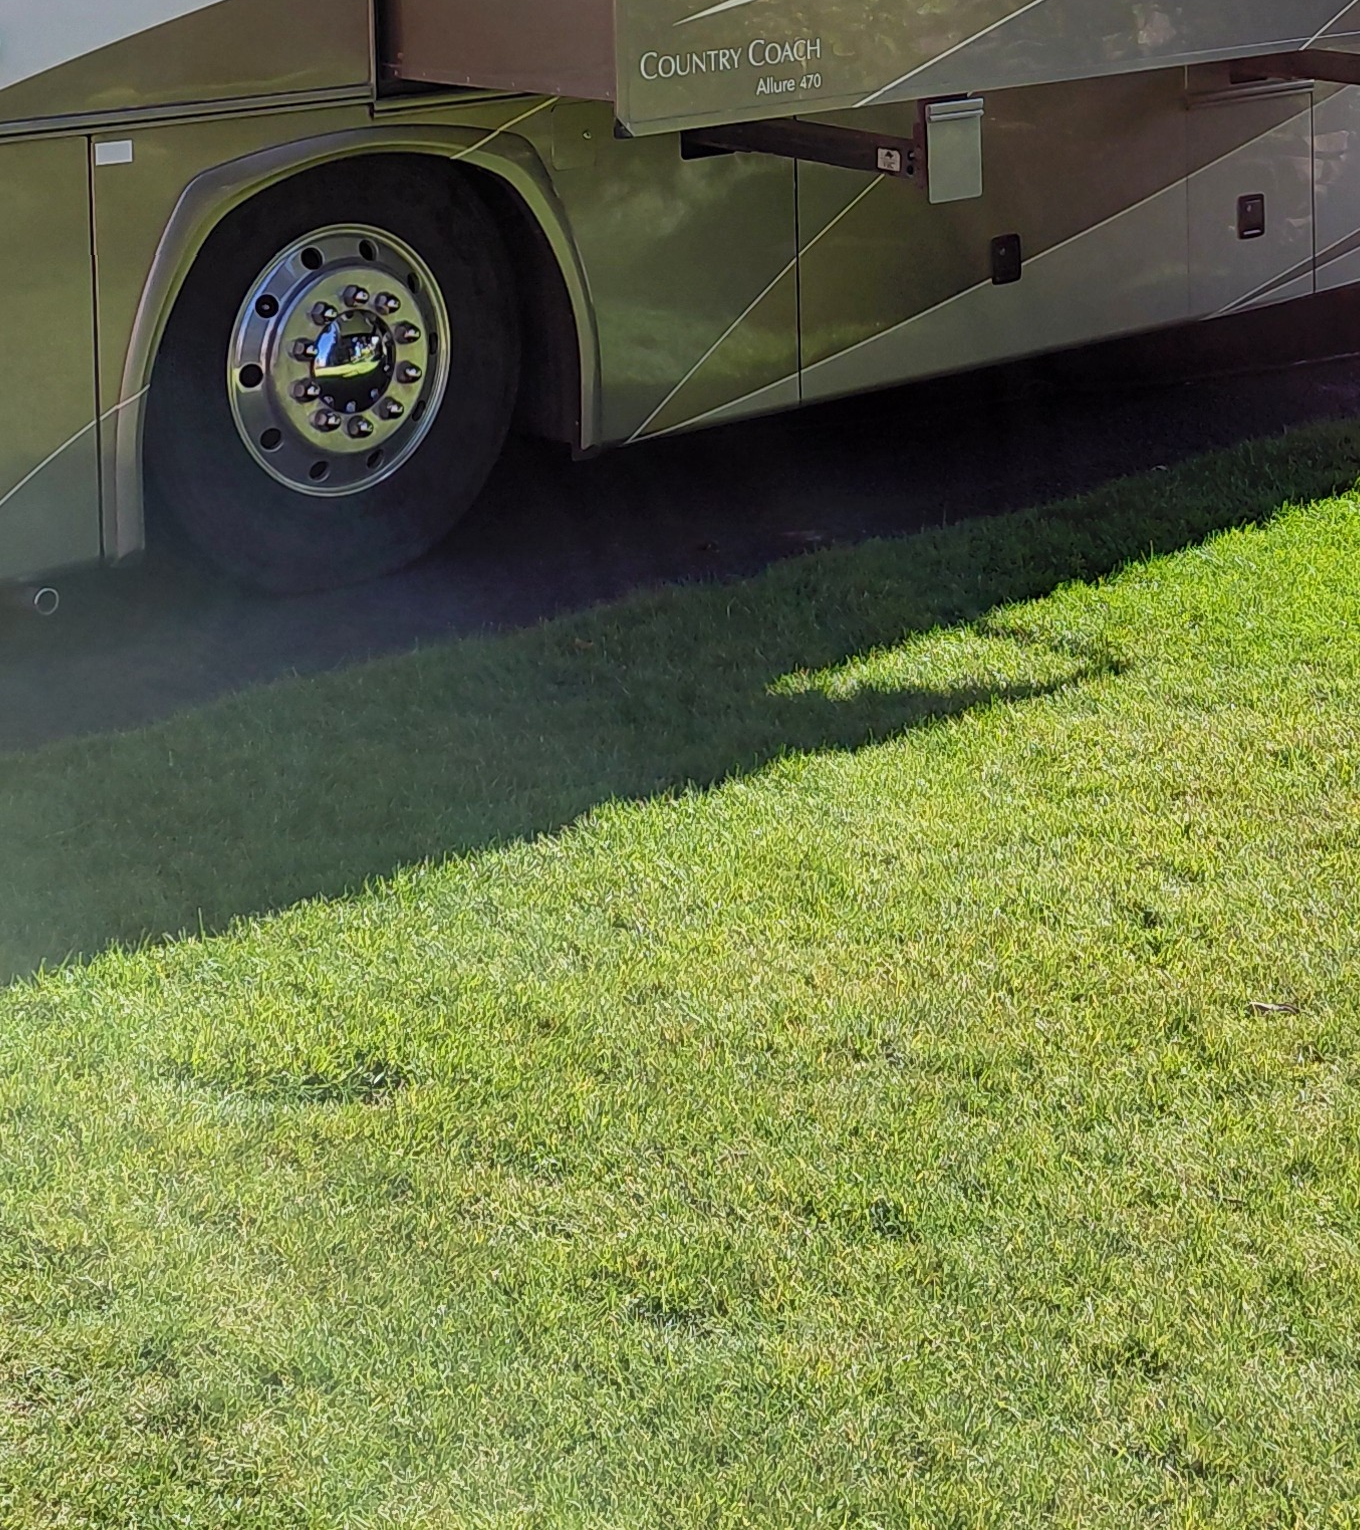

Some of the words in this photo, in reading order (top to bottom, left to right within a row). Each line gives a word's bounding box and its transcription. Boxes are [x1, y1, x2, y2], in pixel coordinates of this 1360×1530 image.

[640, 48, 742, 80] COUNTRY
[748, 38, 822, 67] COACH
[756, 76, 795, 96] Allure
[799, 73, 822, 90] 470
